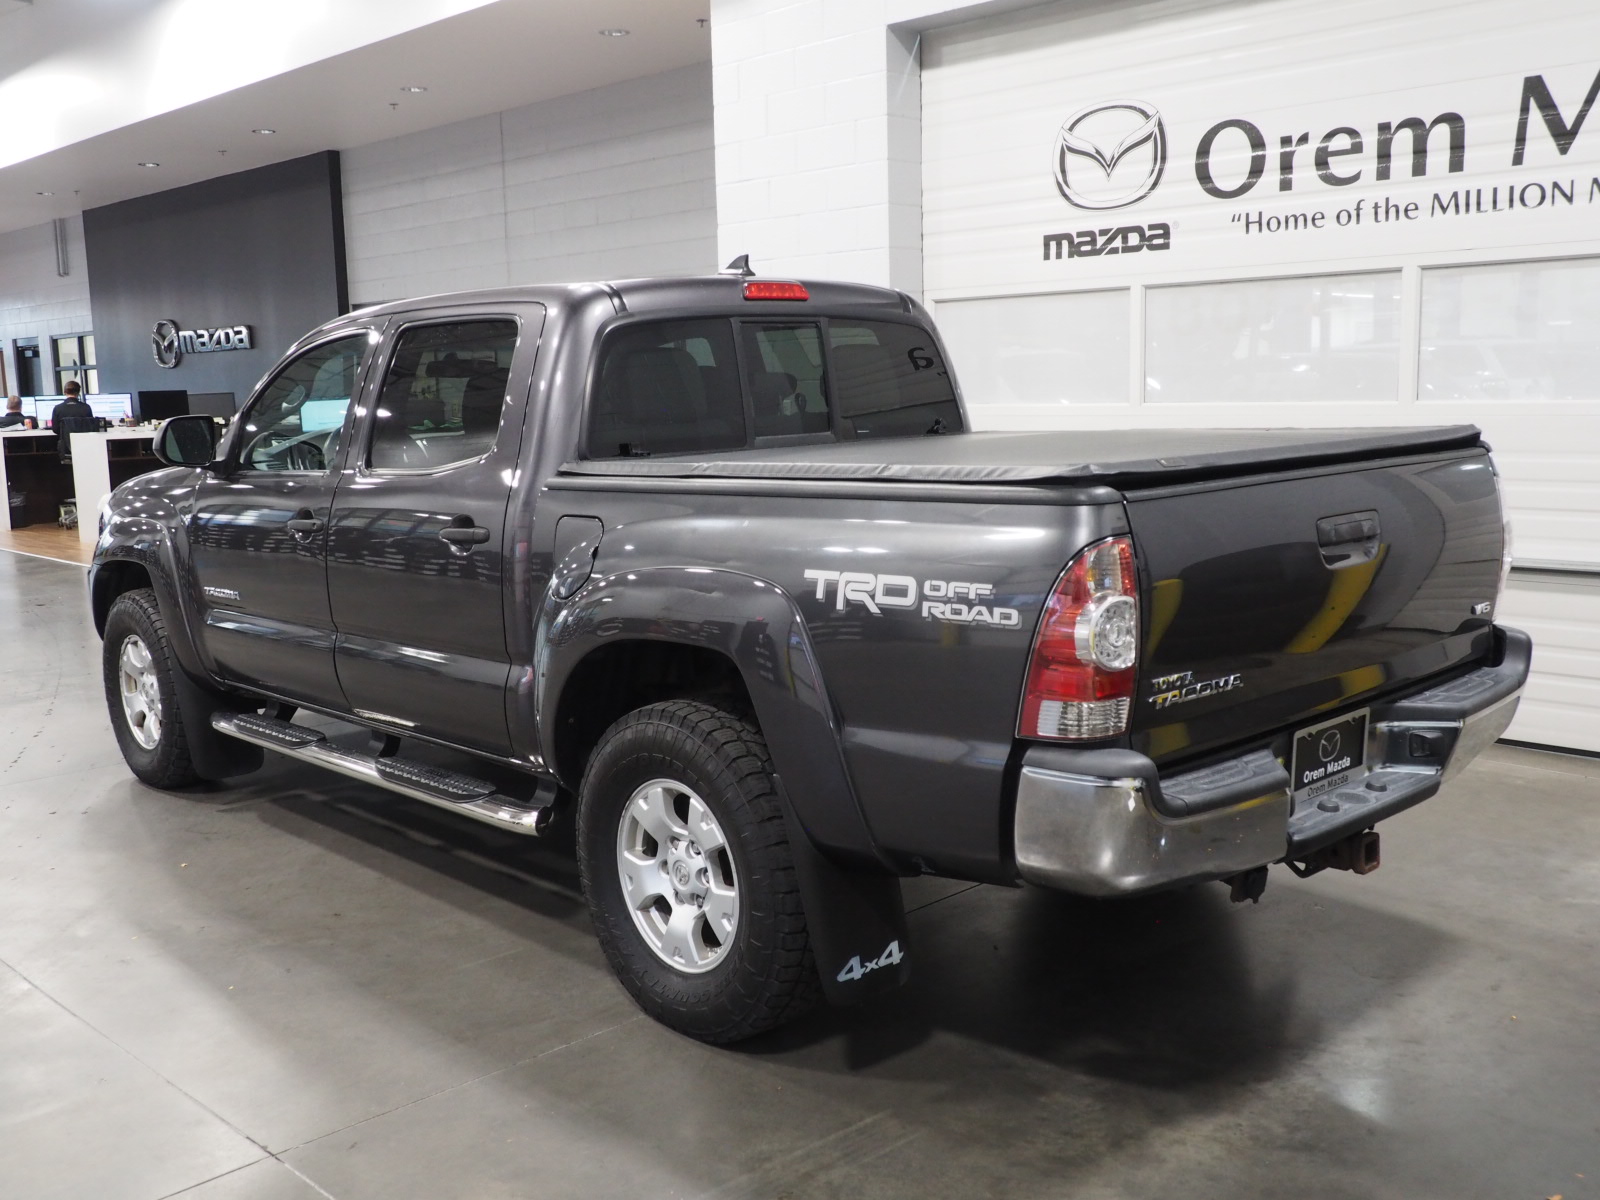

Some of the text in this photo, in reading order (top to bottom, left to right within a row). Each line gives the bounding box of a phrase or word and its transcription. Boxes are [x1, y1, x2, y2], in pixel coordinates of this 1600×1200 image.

[1194, 111, 1465, 199] Orem
[1336, 199, 1365, 226] of
[1372, 197, 1419, 223] the
[1431, 179, 1574, 218] MILLION
[803, 568, 919, 617] TRD
[923, 580, 995, 603] OFF
[922, 601, 1022, 630] ROAD
[1148, 673, 1244, 710] TACOMA
[1152, 671, 1195, 692] TOYOTA
[1303, 756, 1351, 783] Orem Mazda
[1307, 774, 1349, 797] Orem Mazda
[836, 939, 904, 982] 4x4
